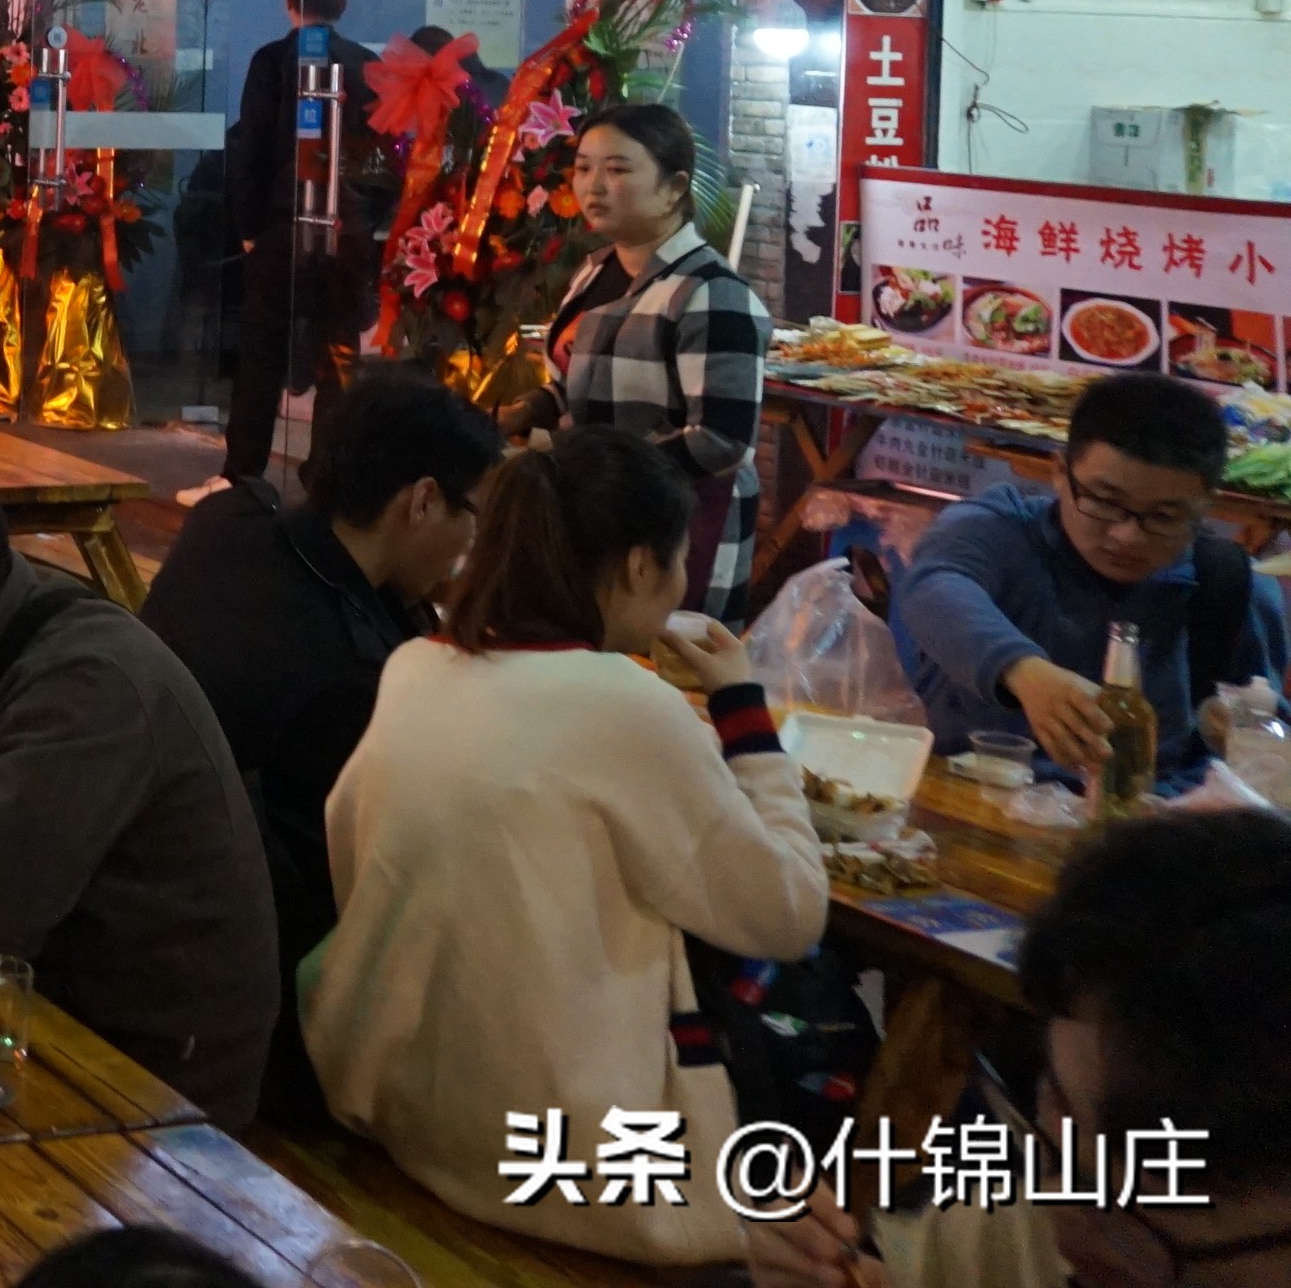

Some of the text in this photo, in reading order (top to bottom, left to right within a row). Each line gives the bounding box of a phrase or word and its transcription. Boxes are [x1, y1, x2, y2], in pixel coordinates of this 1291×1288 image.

[980, 214, 1277, 286] 海鲜烧烤小
